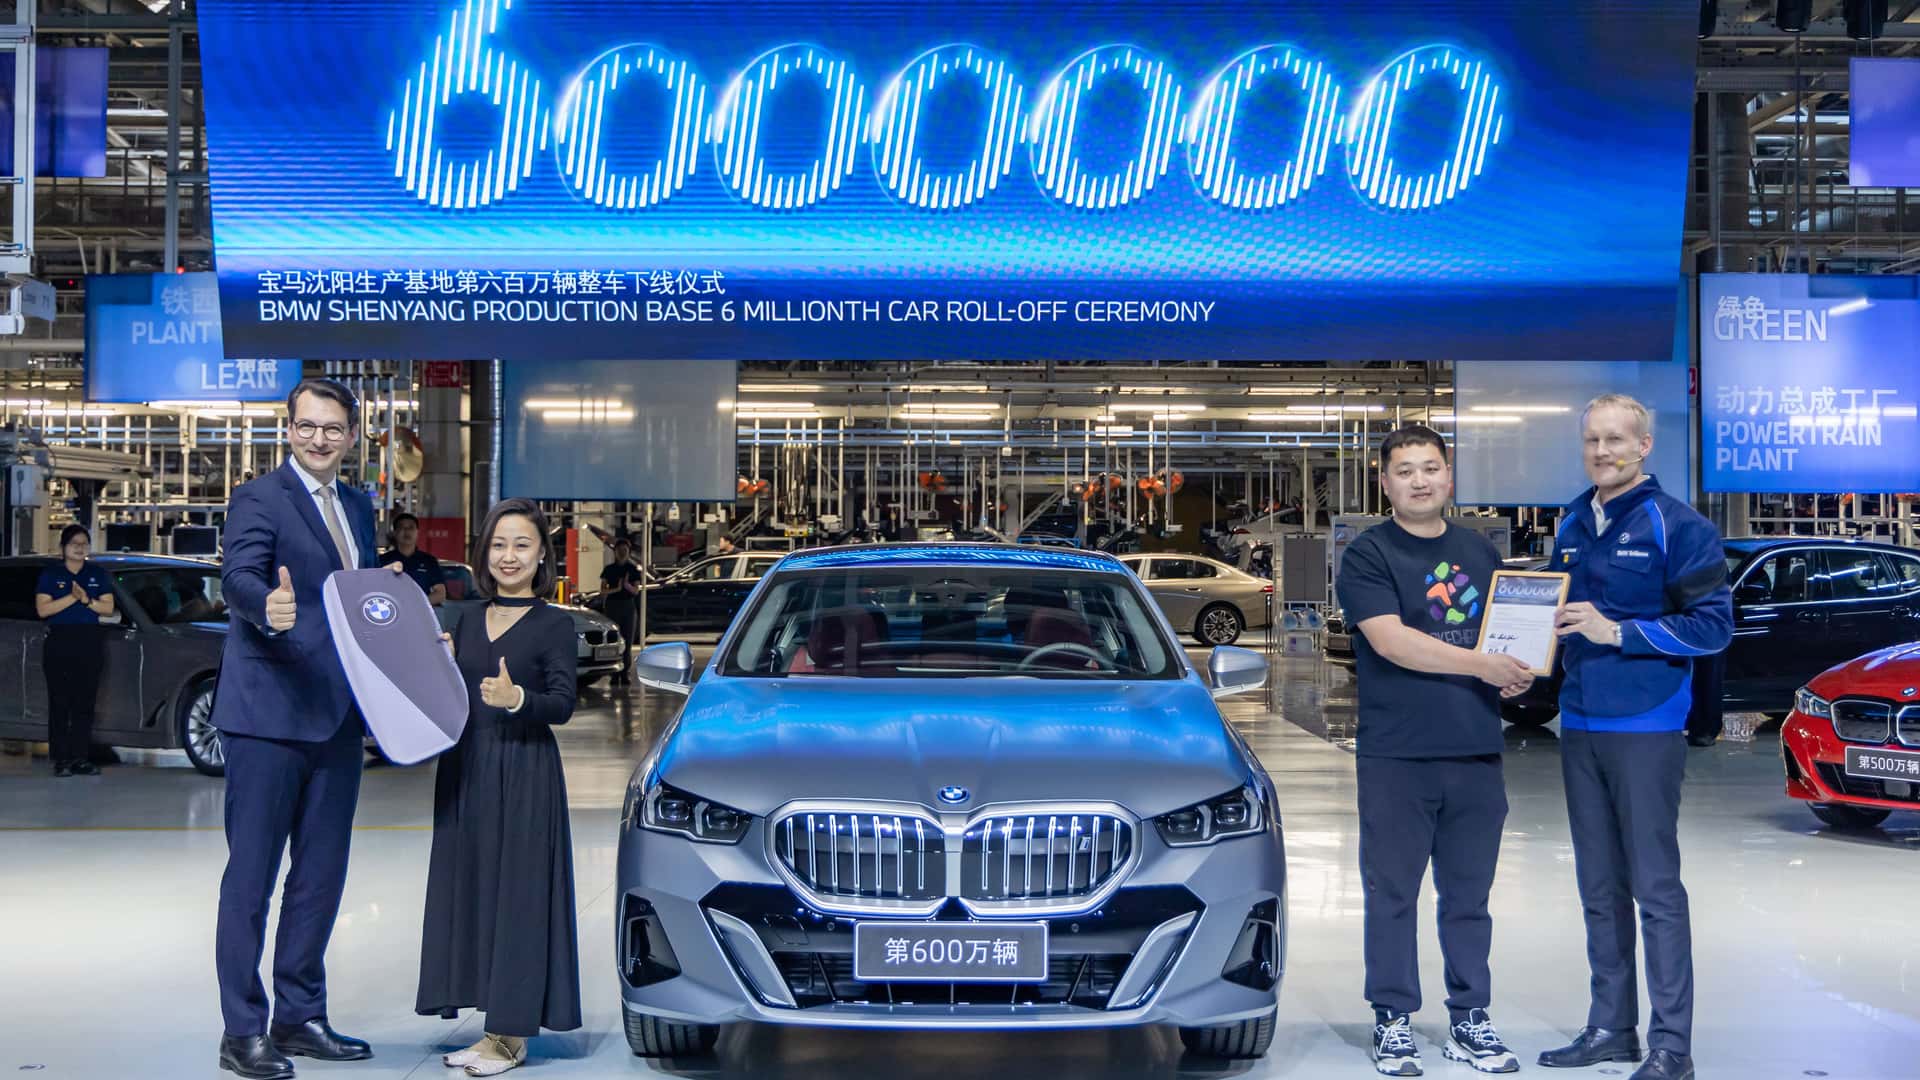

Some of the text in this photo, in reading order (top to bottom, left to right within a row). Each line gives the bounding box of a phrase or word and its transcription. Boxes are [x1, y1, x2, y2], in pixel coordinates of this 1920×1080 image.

[386, 0, 1503, 210] 6000000
[257, 268, 727, 296] 宝马沈阳生产基地第六百万辆整车下线仪式
[259, 299, 1215, 322] BMW SHENYANG PRODUCTION BASE 6 MILLIONTH CAR ROLL-OFF CEREMONY
[131, 321, 211, 345] PLANT
[1714, 309, 1828, 341] GREEN
[201, 363, 277, 390] LEAN
[1716, 386, 1899, 415] 动力总成工厂
[1716, 420, 1882, 446] POWERTRAIN
[1716, 447, 1799, 471] PLANT
[1858, 755, 1920, 775] 第500万辆
[884, 937, 1019, 965] 第600万辆
